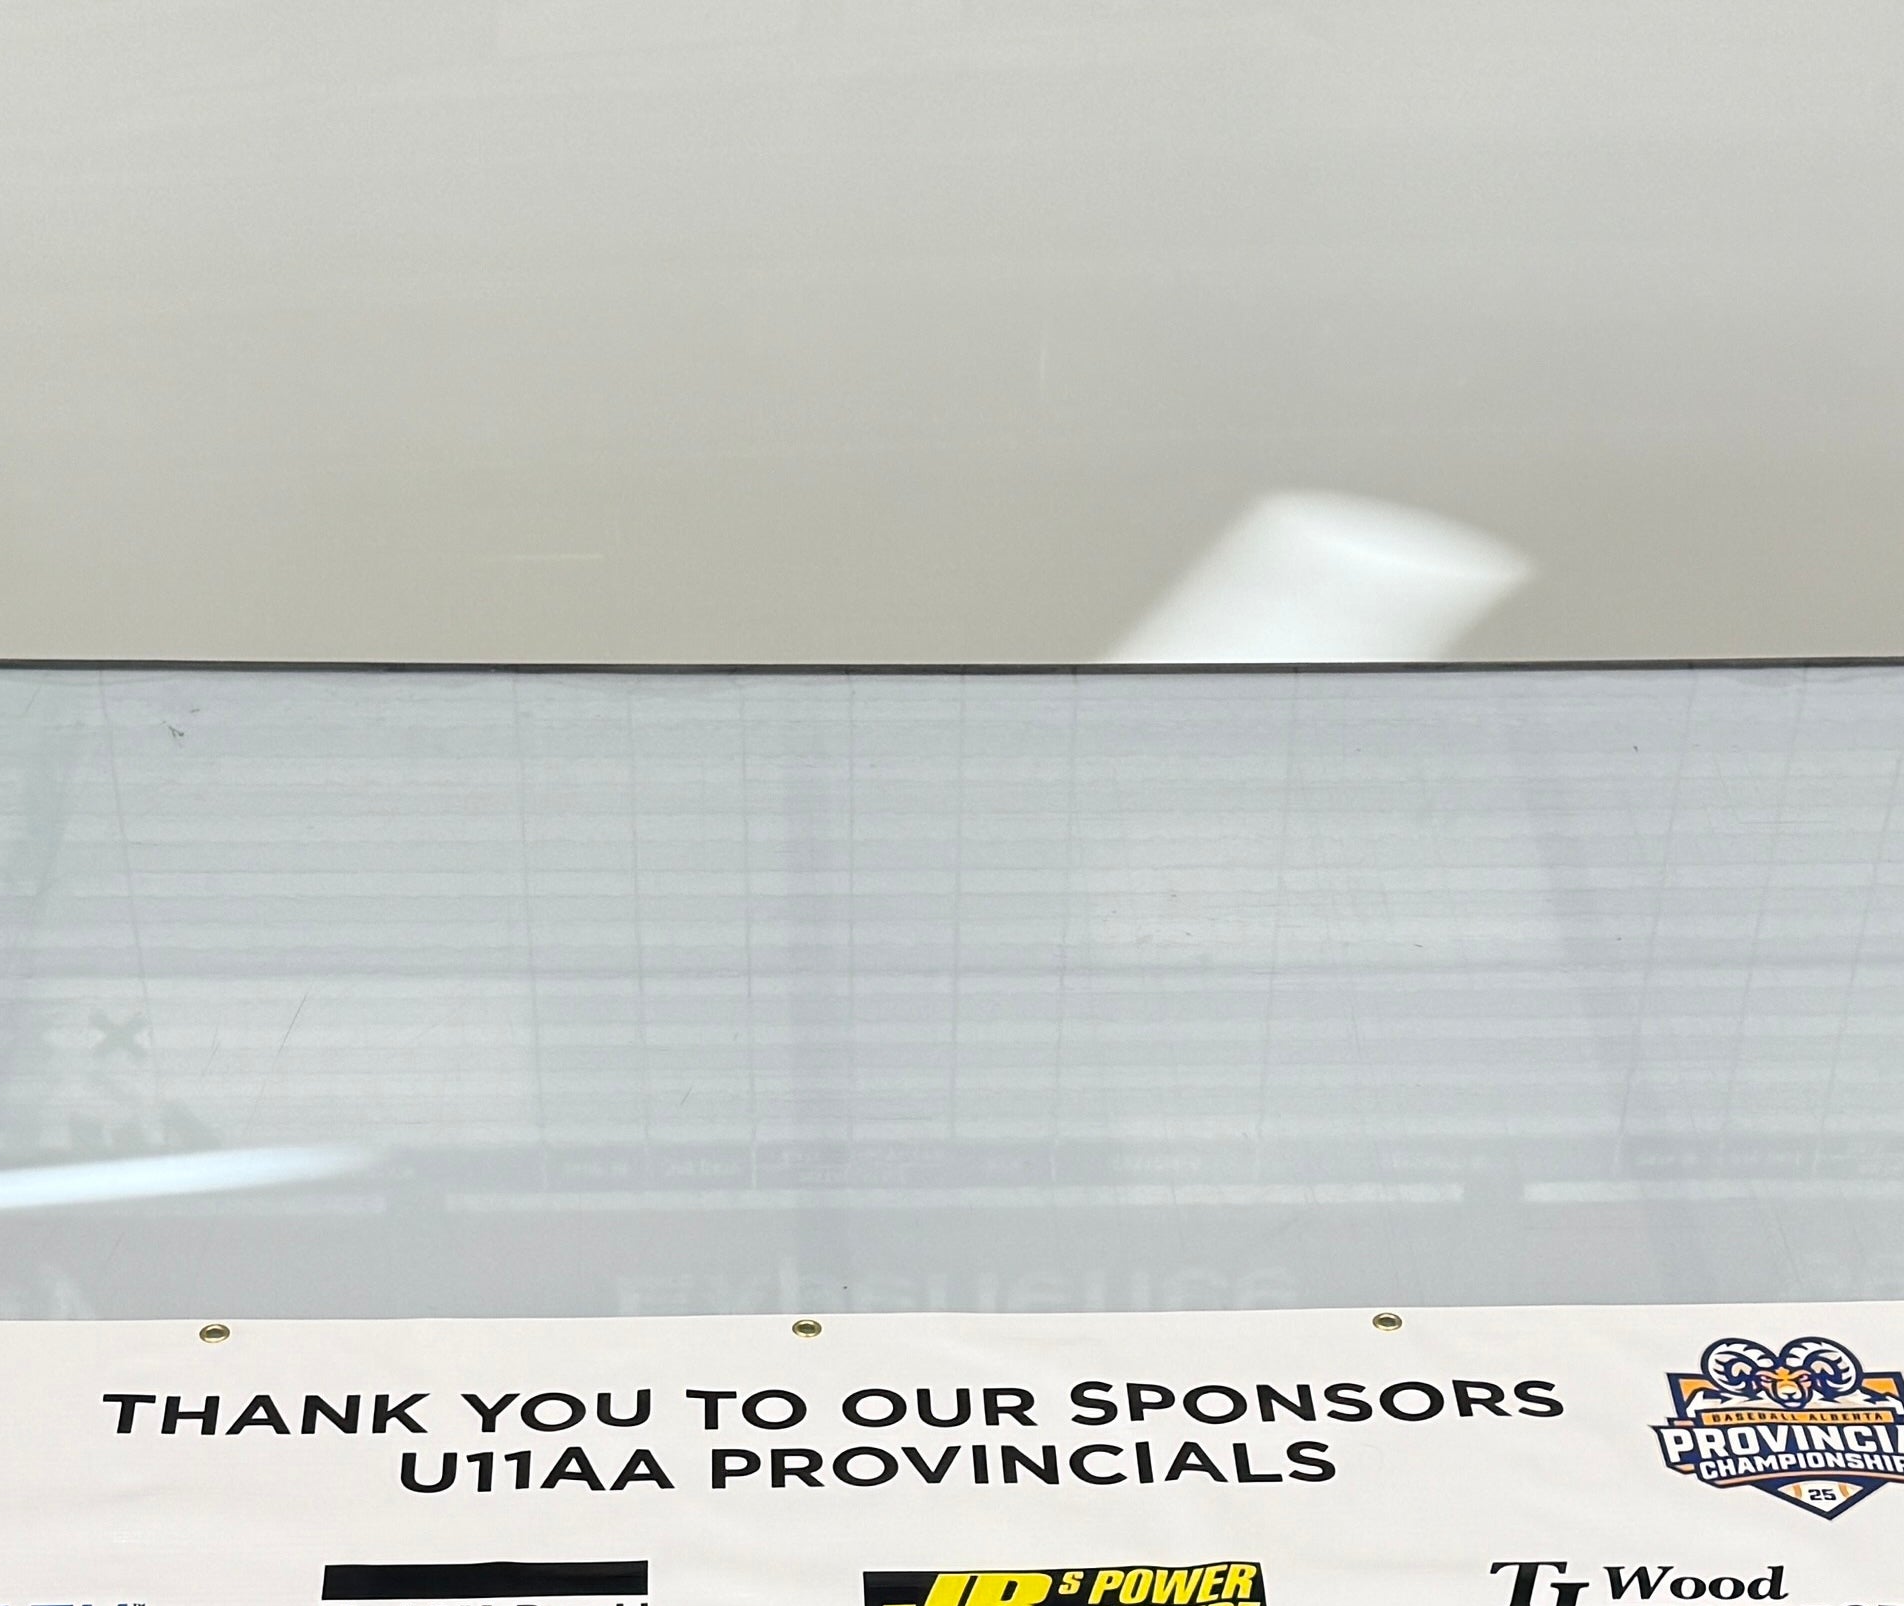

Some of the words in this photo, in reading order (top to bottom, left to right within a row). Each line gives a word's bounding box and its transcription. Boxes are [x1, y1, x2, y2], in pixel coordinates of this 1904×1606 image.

[103, 1394, 430, 1436] THANK
[462, 1388, 651, 1433] YOU
[686, 1388, 807, 1431] TO
[842, 1387, 1038, 1427] OUR
[1070, 1379, 1564, 1426] SPONSORS
[401, 1446, 675, 1493] U11AA
[711, 1440, 1336, 1488] PROVINCIALS
[1807, 1488, 1837, 1501] 25
[1088, 1562, 1256, 1604] POWER
[1604, 1565, 1789, 1600] Wood
